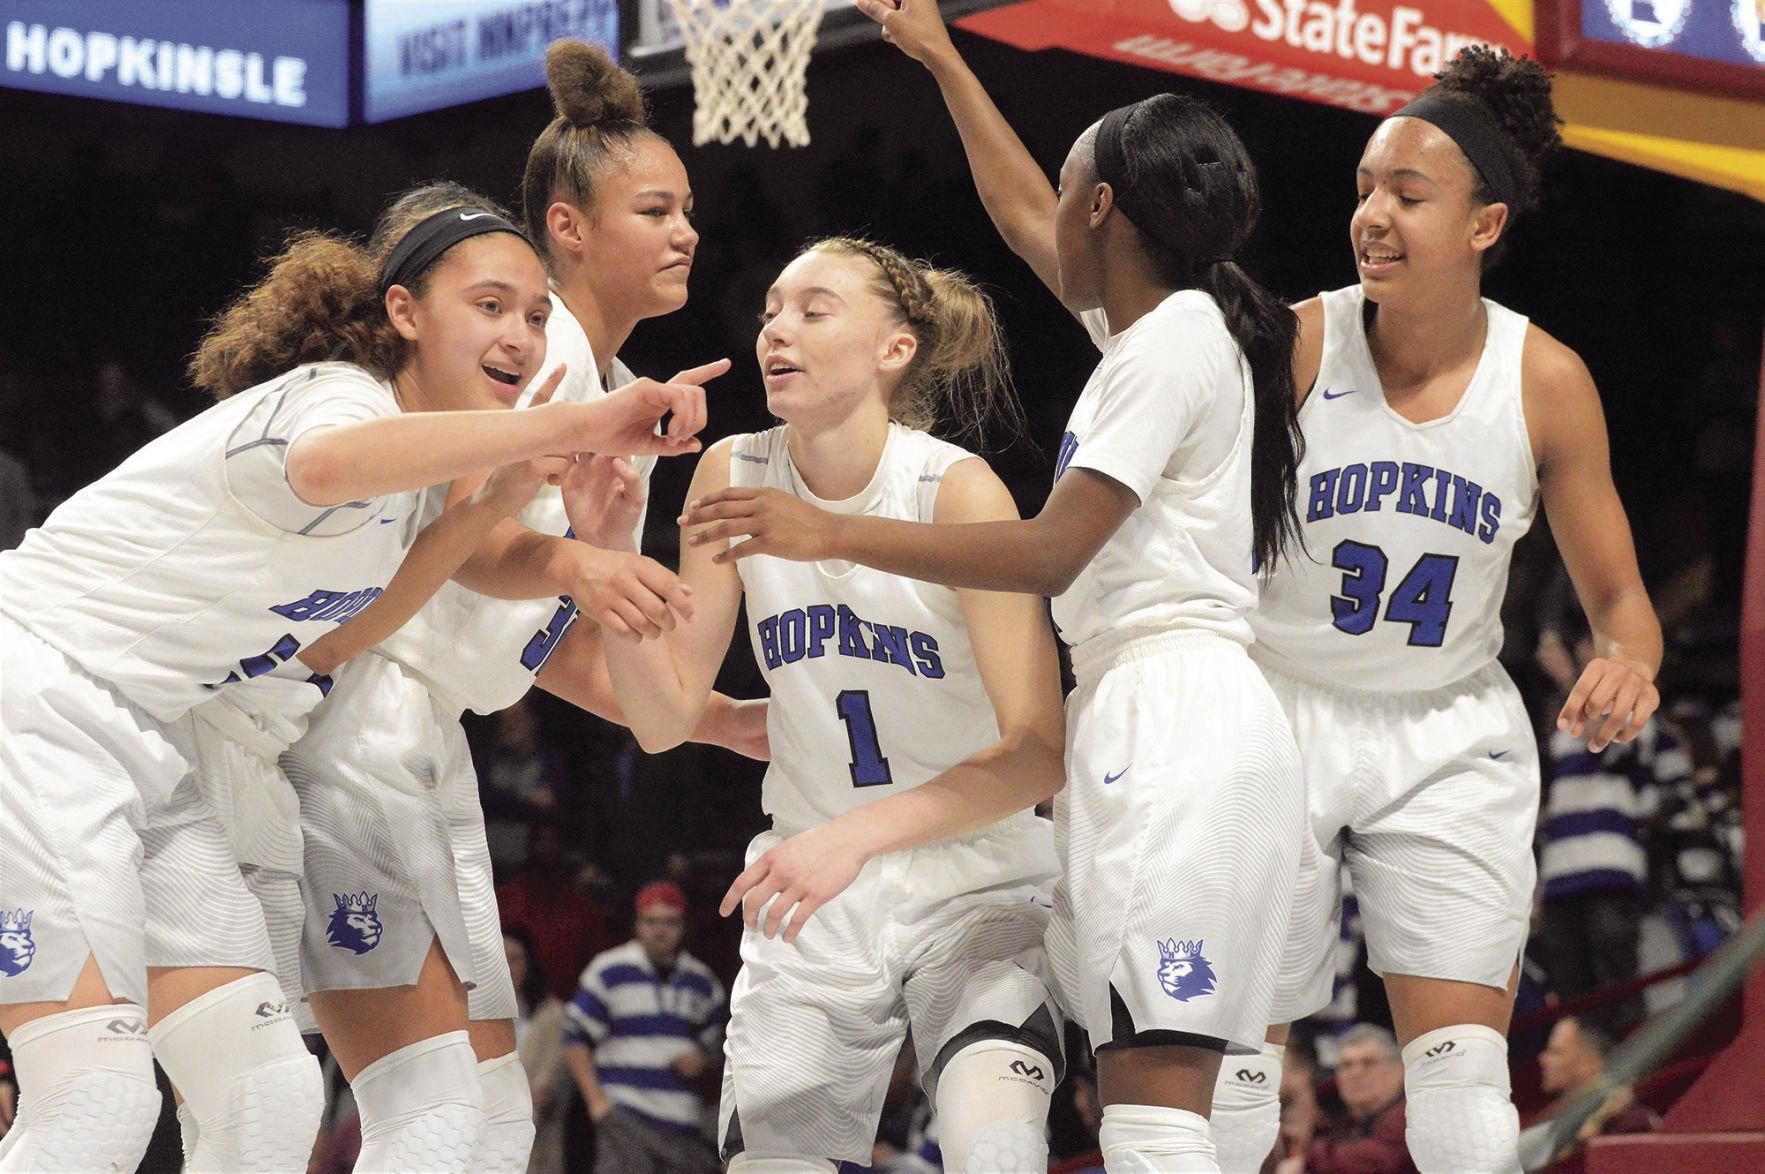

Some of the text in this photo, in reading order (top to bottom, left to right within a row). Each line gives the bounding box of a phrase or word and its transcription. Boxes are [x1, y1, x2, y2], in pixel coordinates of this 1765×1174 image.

[6, 20, 307, 108] HOPKINSLE
[1306, 461, 1502, 545] HOPKINS
[1330, 538, 1460, 647] 34
[836, 689, 894, 788] 1
